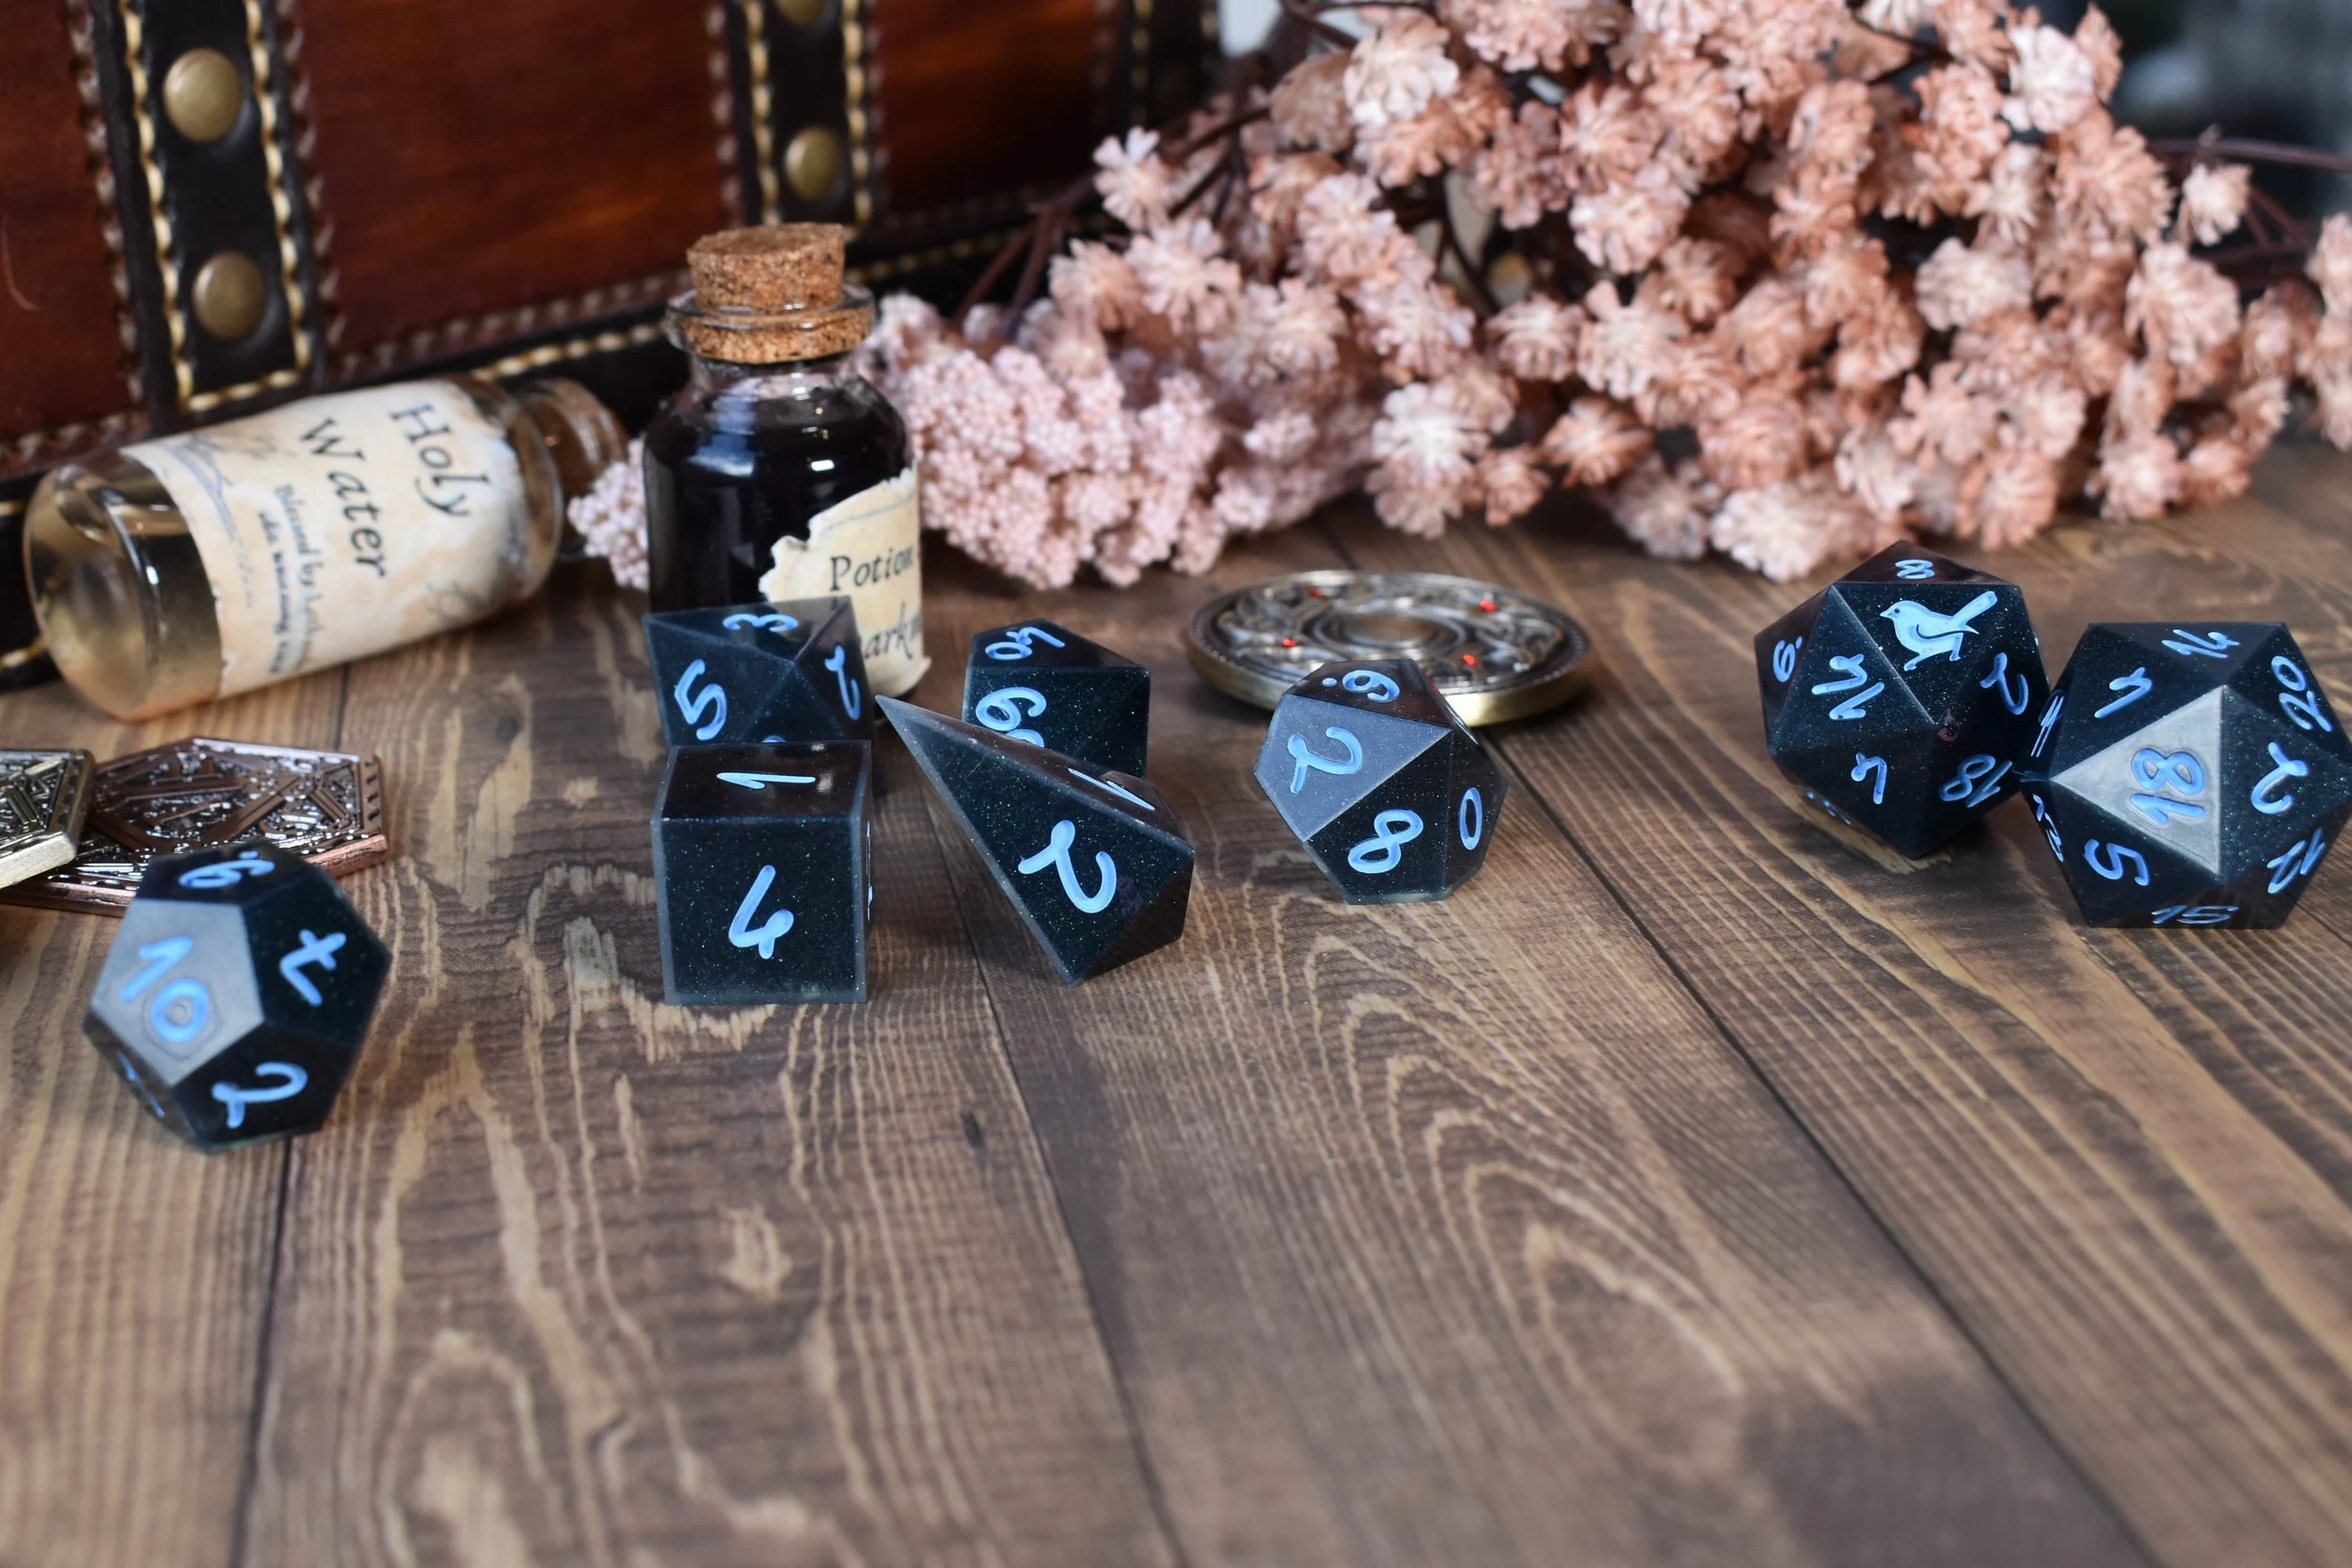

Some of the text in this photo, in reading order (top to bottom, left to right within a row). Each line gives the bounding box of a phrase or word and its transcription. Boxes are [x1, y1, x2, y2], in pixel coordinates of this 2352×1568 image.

[298, 417, 387, 578] Water
[389, 400, 489, 519] Holy
[722, 611, 800, 634] 3
[673, 657, 728, 741] 5
[2270, 655, 2334, 733] 20
[717, 771, 816, 790] 1
[1287, 724, 1364, 795] 2
[2131, 748, 2207, 825] 18
[2249, 740, 2311, 817] 2
[1347, 808, 1424, 874] 8
[1457, 786, 1484, 851] 0
[1017, 819, 1118, 914] 2
[2083, 838, 2151, 887] 5
[727, 863, 795, 960] 4
[119, 934, 210, 1044] 10
[211, 1061, 309, 1130] 2
